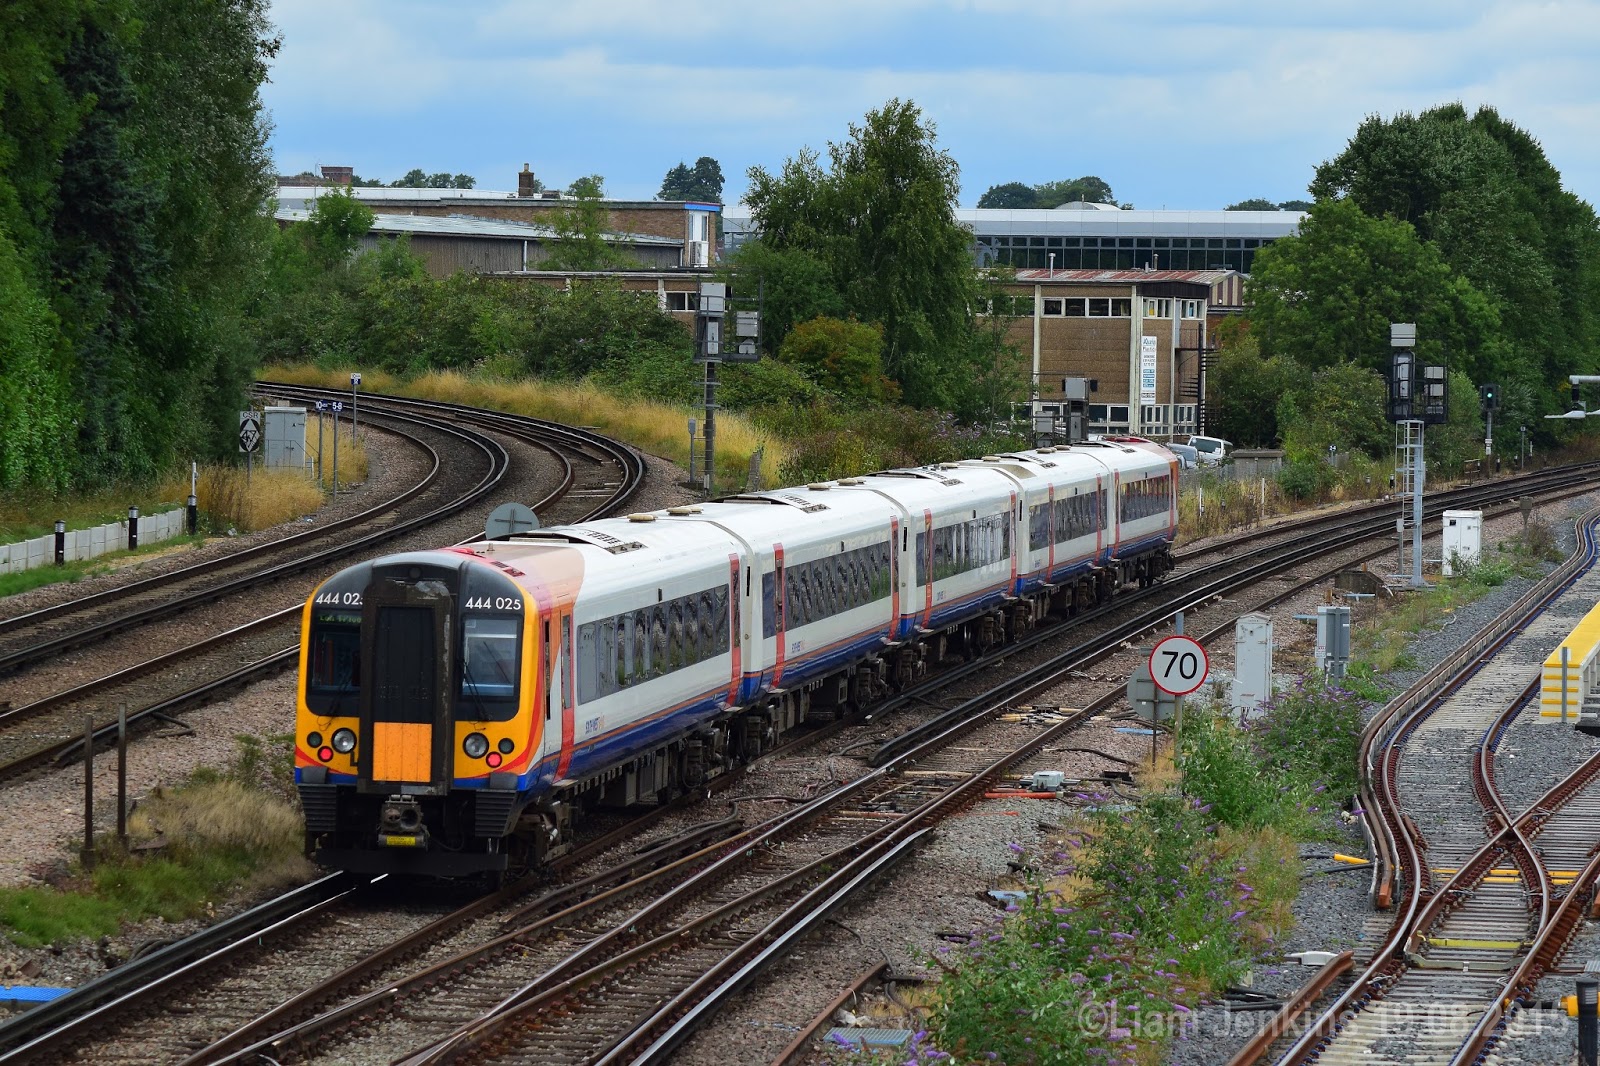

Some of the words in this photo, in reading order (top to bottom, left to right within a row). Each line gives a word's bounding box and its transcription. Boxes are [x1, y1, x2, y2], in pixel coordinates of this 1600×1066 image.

[315, 592, 340, 605] 444
[465, 596, 491, 610] 444
[495, 597, 521, 611] 025
[1161, 650, 1198, 680] 70
